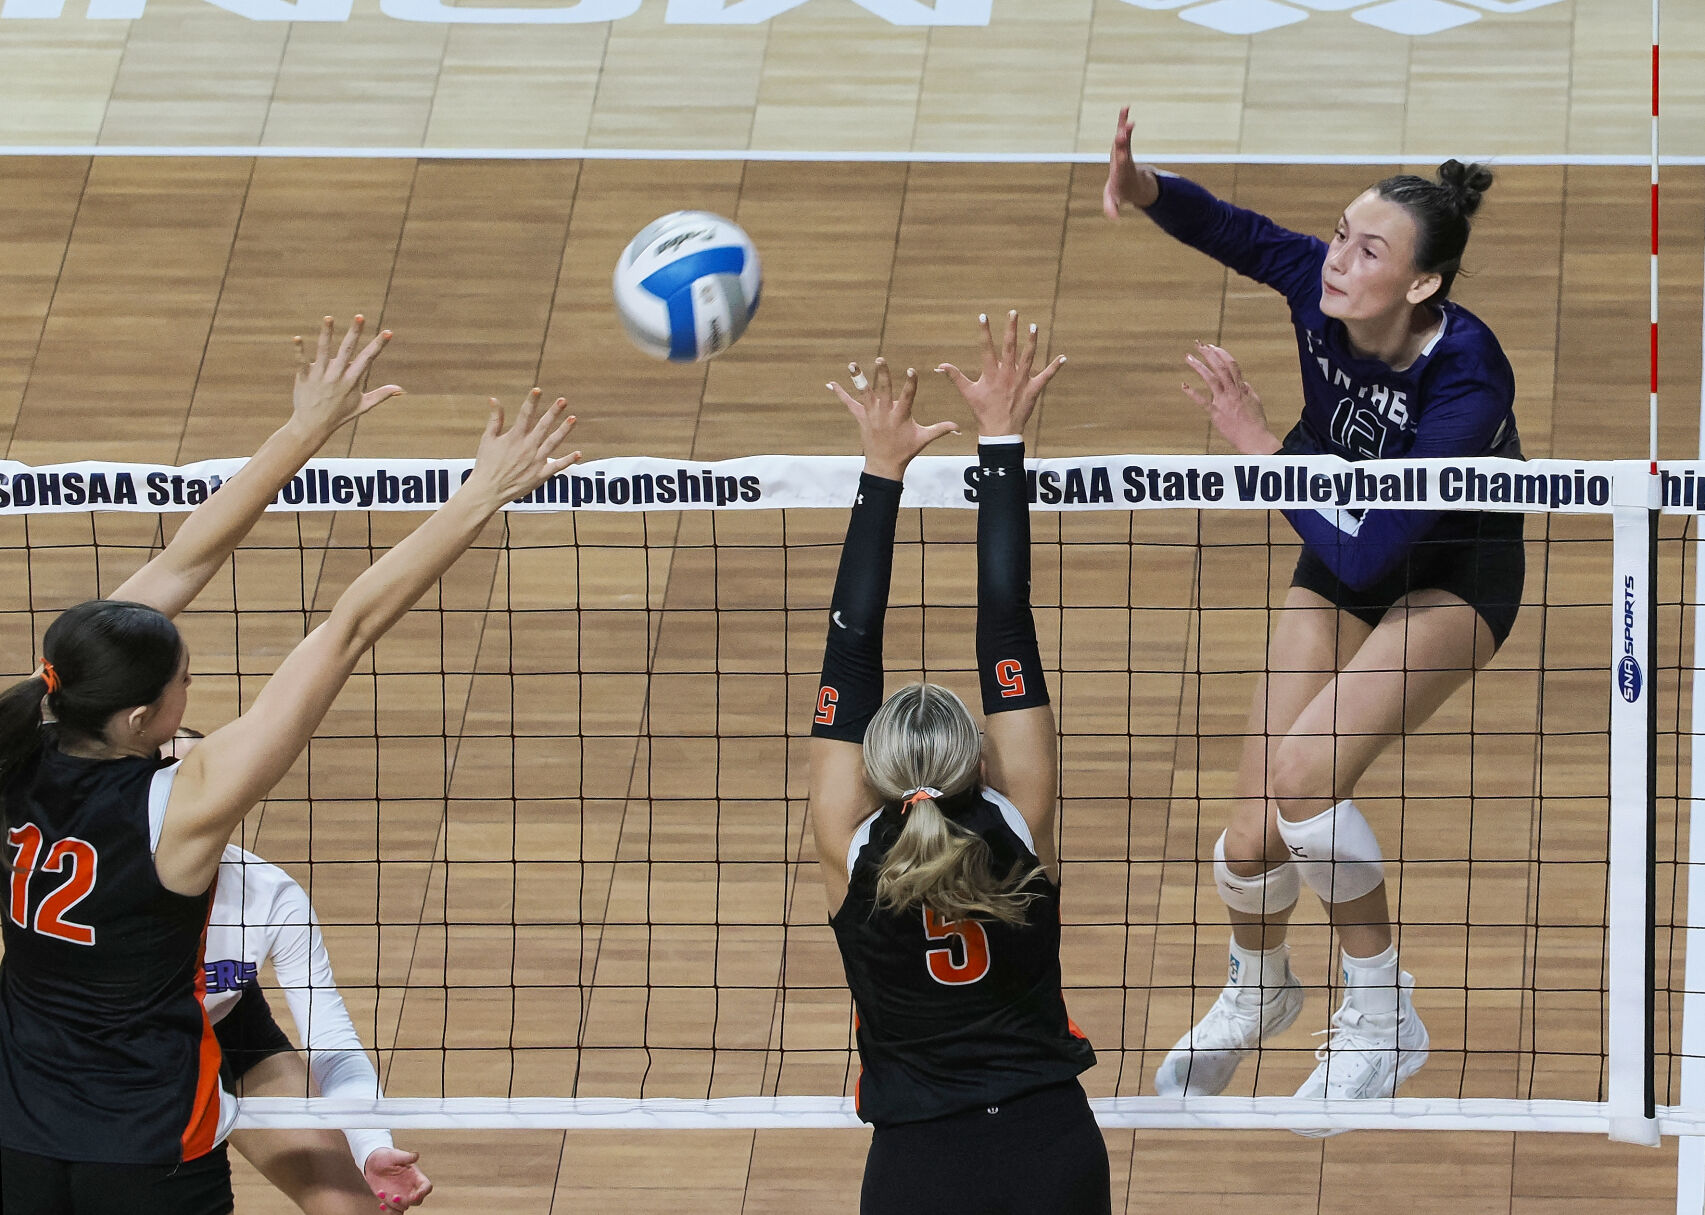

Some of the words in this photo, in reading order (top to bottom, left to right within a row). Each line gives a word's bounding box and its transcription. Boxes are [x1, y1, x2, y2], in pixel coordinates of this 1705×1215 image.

[269, 468, 449, 508] olleyball
[461, 467, 762, 507] mpionships
[963, 465, 1114, 505] SSAA
[1122, 465, 1225, 504] State
[1234, 465, 1428, 507] Volleyball
[1624, 574, 1636, 656] SPORTS
[994, 658, 1026, 699] 5
[1623, 659, 1635, 702] SNA
[814, 685, 840, 726] 5
[7, 822, 98, 946] 12
[921, 900, 991, 986] 5
